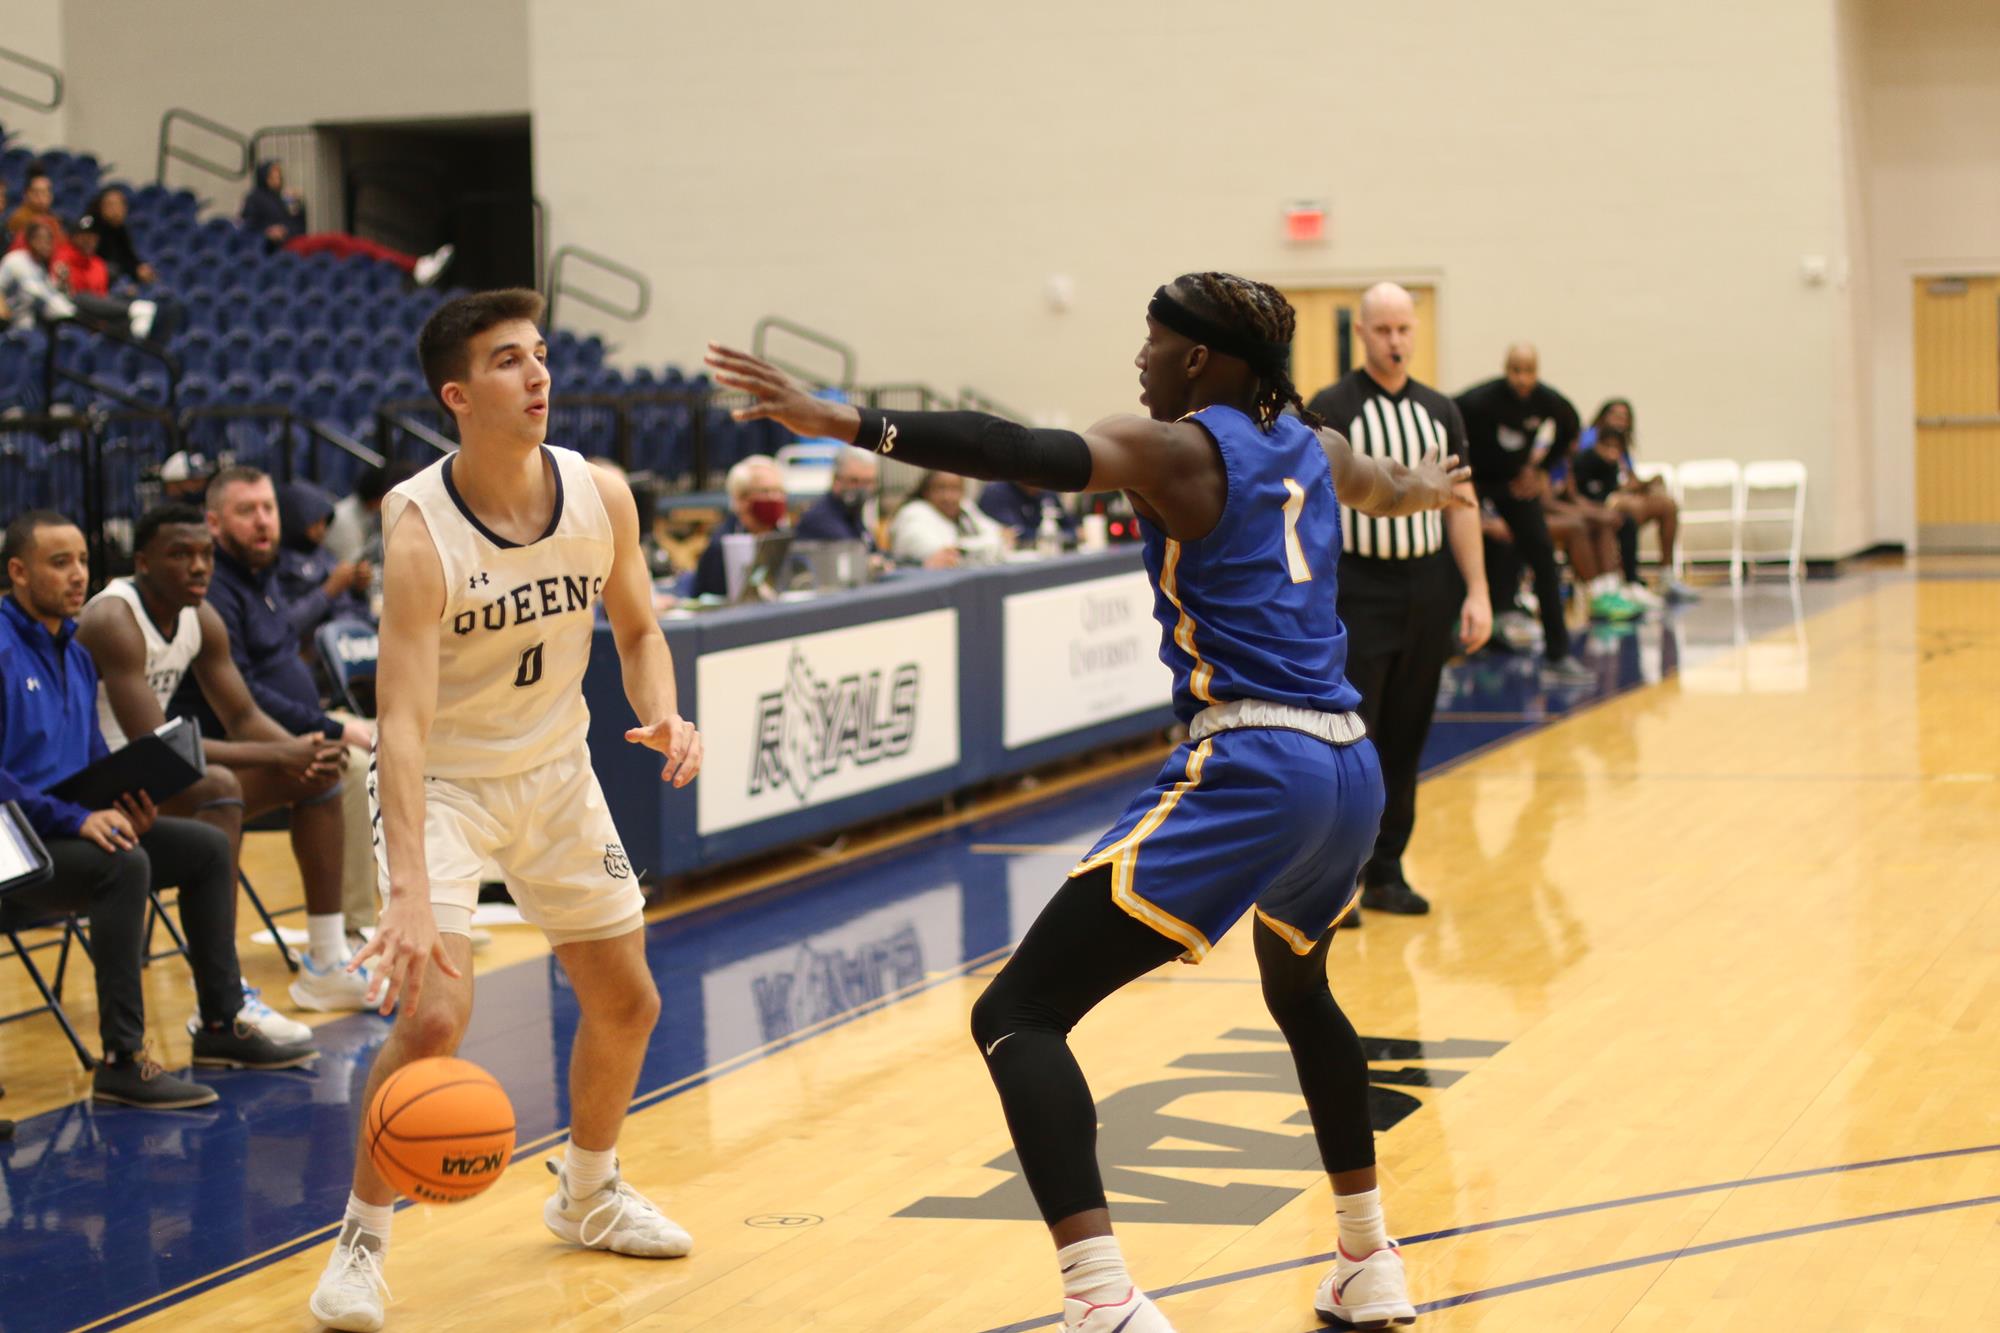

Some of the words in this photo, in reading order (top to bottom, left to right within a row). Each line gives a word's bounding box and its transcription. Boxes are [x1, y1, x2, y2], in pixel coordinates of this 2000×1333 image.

[1281, 477, 1313, 584] 1
[514, 642, 544, 687] 0
[441, 1150, 504, 1176] NCAA
